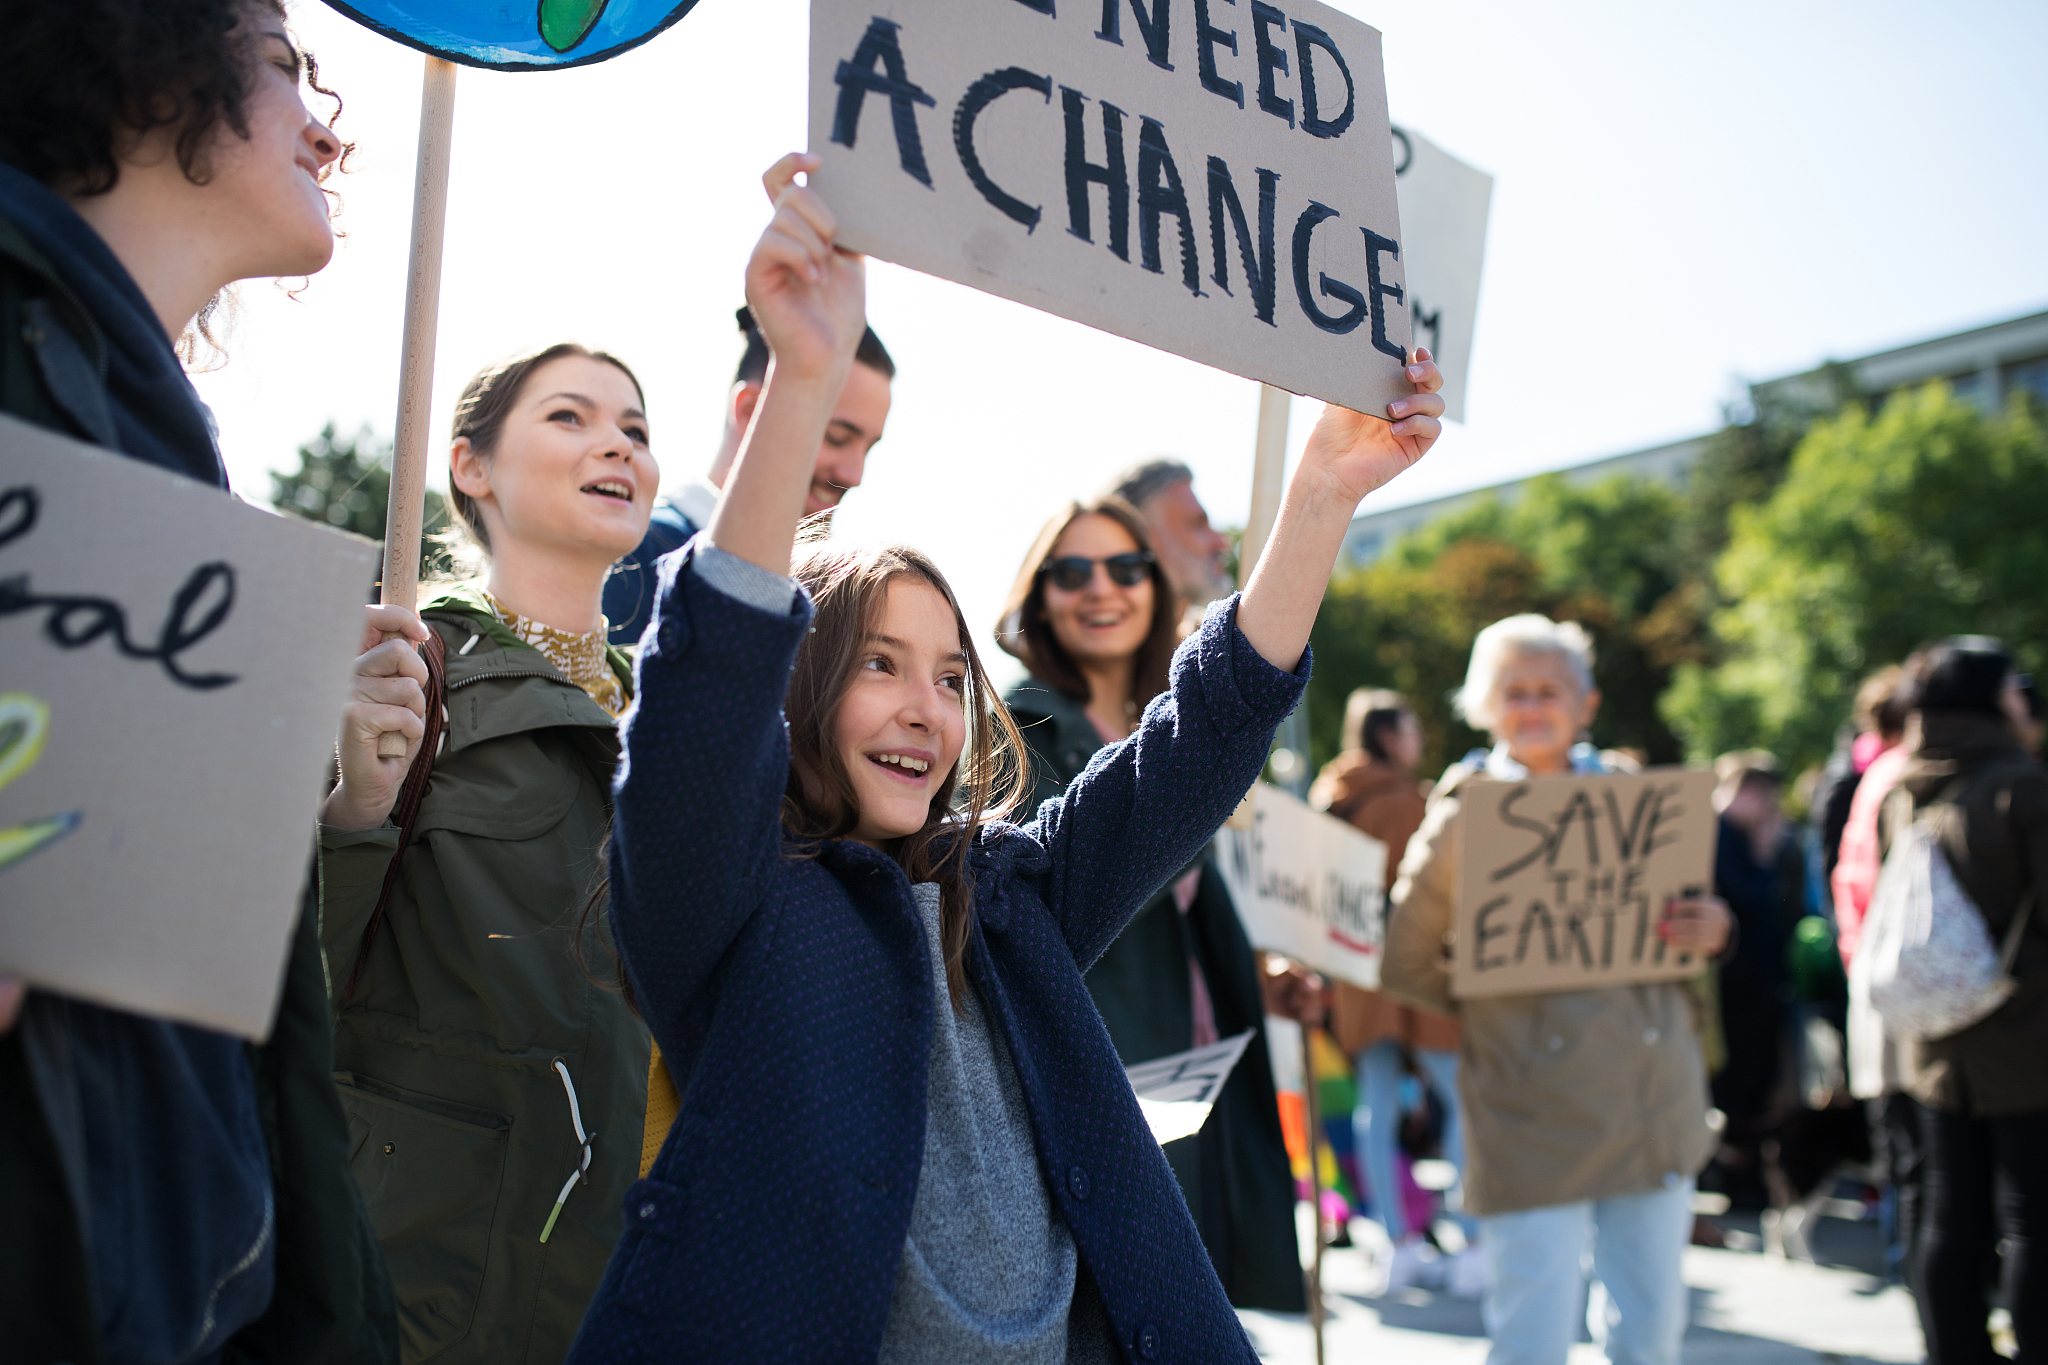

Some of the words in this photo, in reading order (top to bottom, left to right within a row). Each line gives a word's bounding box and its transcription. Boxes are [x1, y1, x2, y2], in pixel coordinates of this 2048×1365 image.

[1093, 0, 1354, 139] NEED
[831, 16, 936, 190] A
[952, 66, 1408, 367] CHANGE
[1491, 781, 1687, 880] SAVE
[1547, 866, 1646, 907] THE
